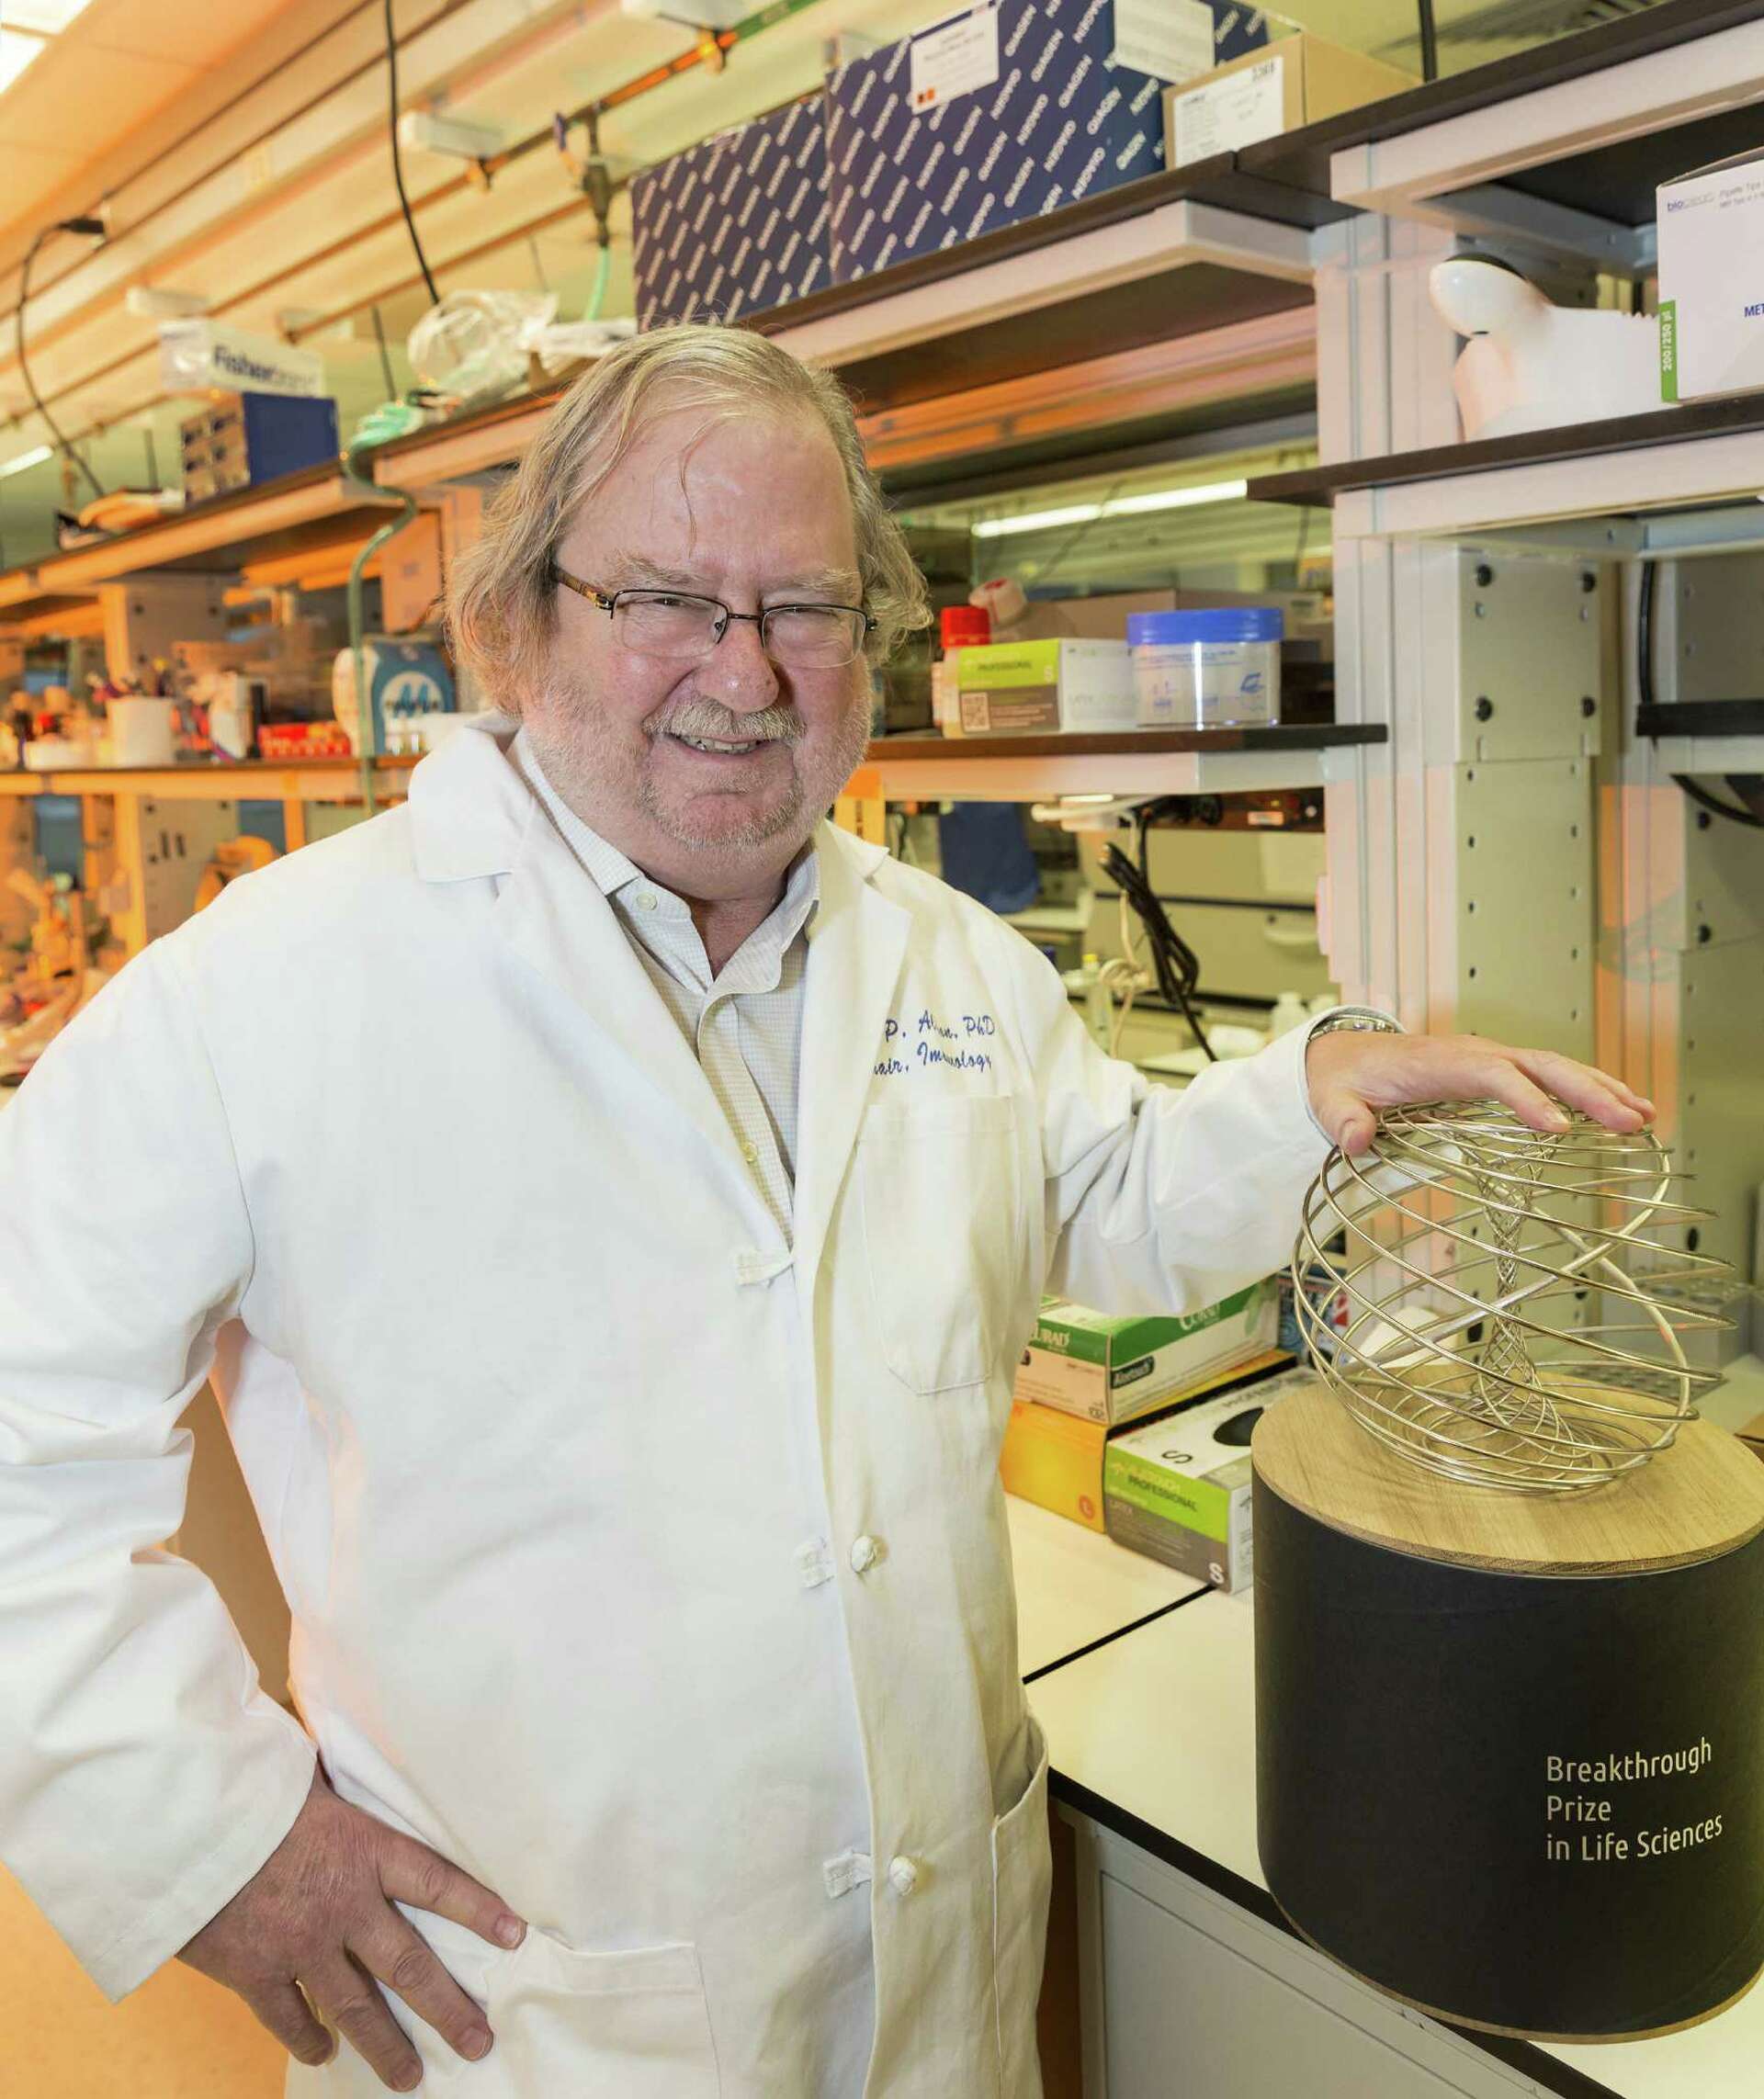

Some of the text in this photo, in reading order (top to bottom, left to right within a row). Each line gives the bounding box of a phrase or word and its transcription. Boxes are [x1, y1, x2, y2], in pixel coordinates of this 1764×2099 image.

[1032, 28, 1064, 82] QIAGEN
[1058, 54, 1091, 108] QIAGEN
[1045, 120, 1076, 172] QIAGEN
[1072, 147, 1105, 200] QIAGEN
[963, 1014, 996, 1037] PhD
[1208, 1562, 1225, 1585] S
[1546, 1735, 1712, 1783] Breakthrough
[1546, 1795, 1611, 1822] Prize
[1546, 1814, 1724, 1861] in Life Sciences
